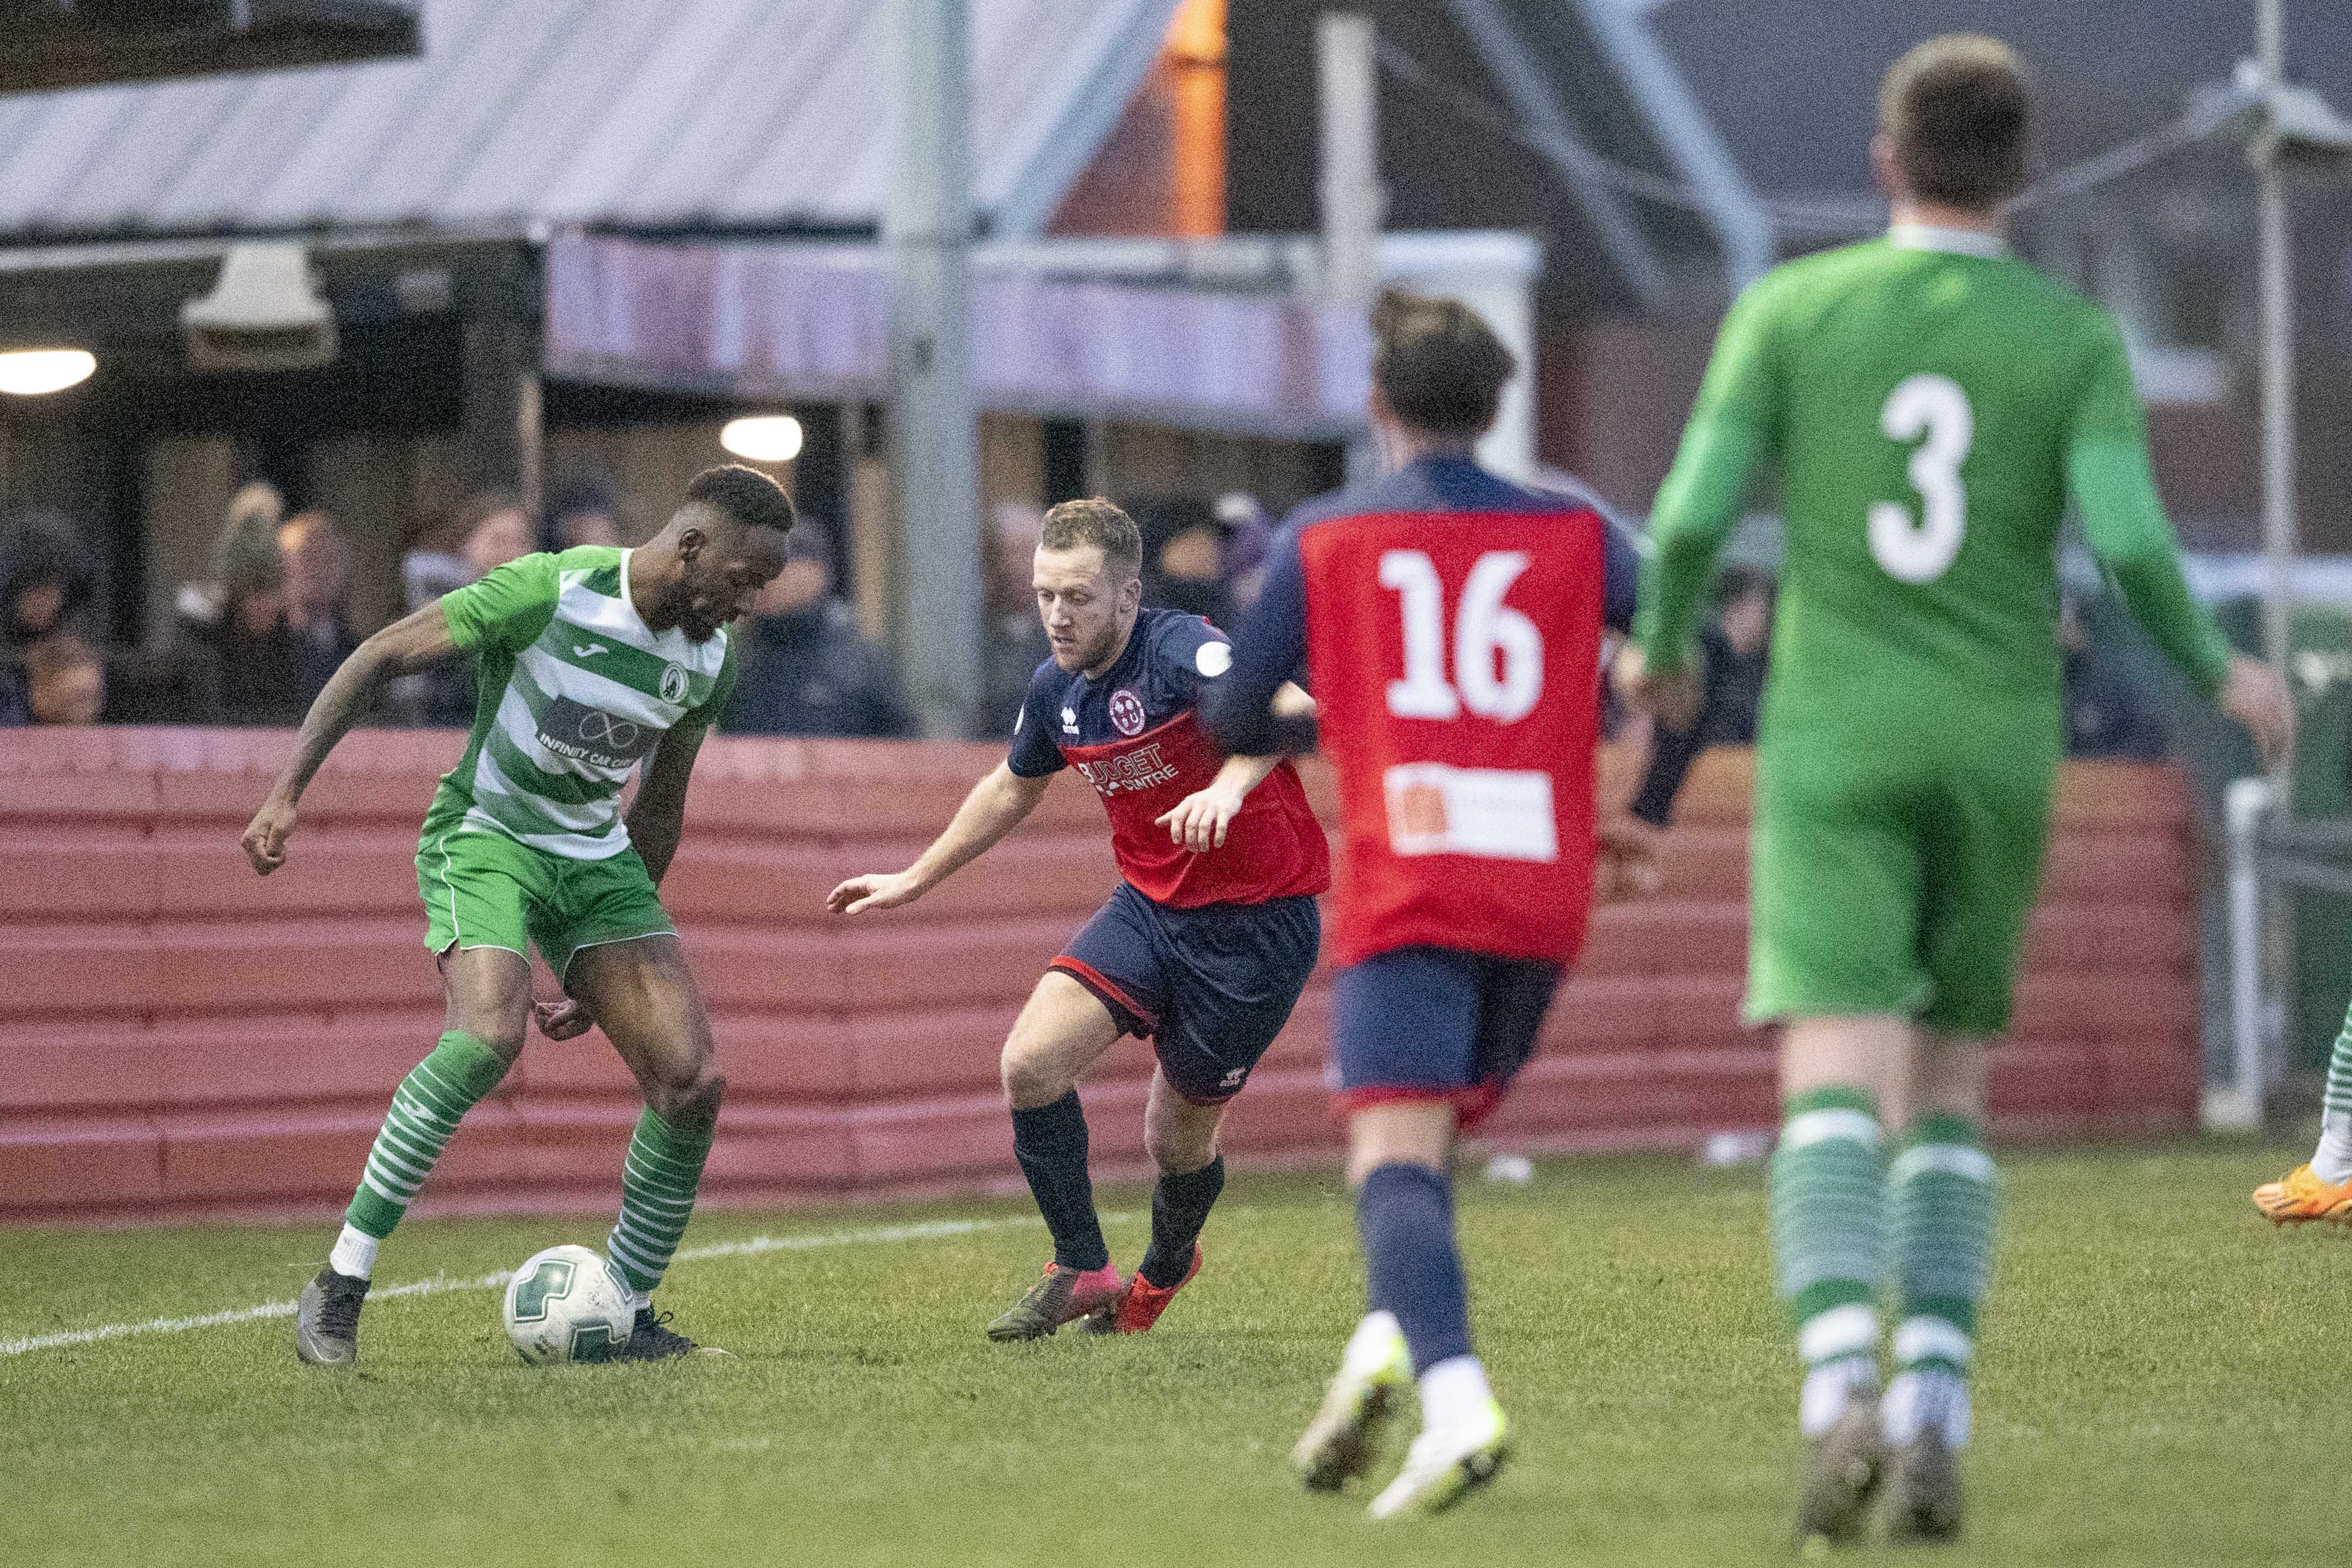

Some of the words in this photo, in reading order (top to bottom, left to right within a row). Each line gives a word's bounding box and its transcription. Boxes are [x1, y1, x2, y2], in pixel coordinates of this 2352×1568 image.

[1869, 373, 1972, 583] 3
[1379, 550, 1544, 723] 16
[539, 732, 589, 759] INFINITY
